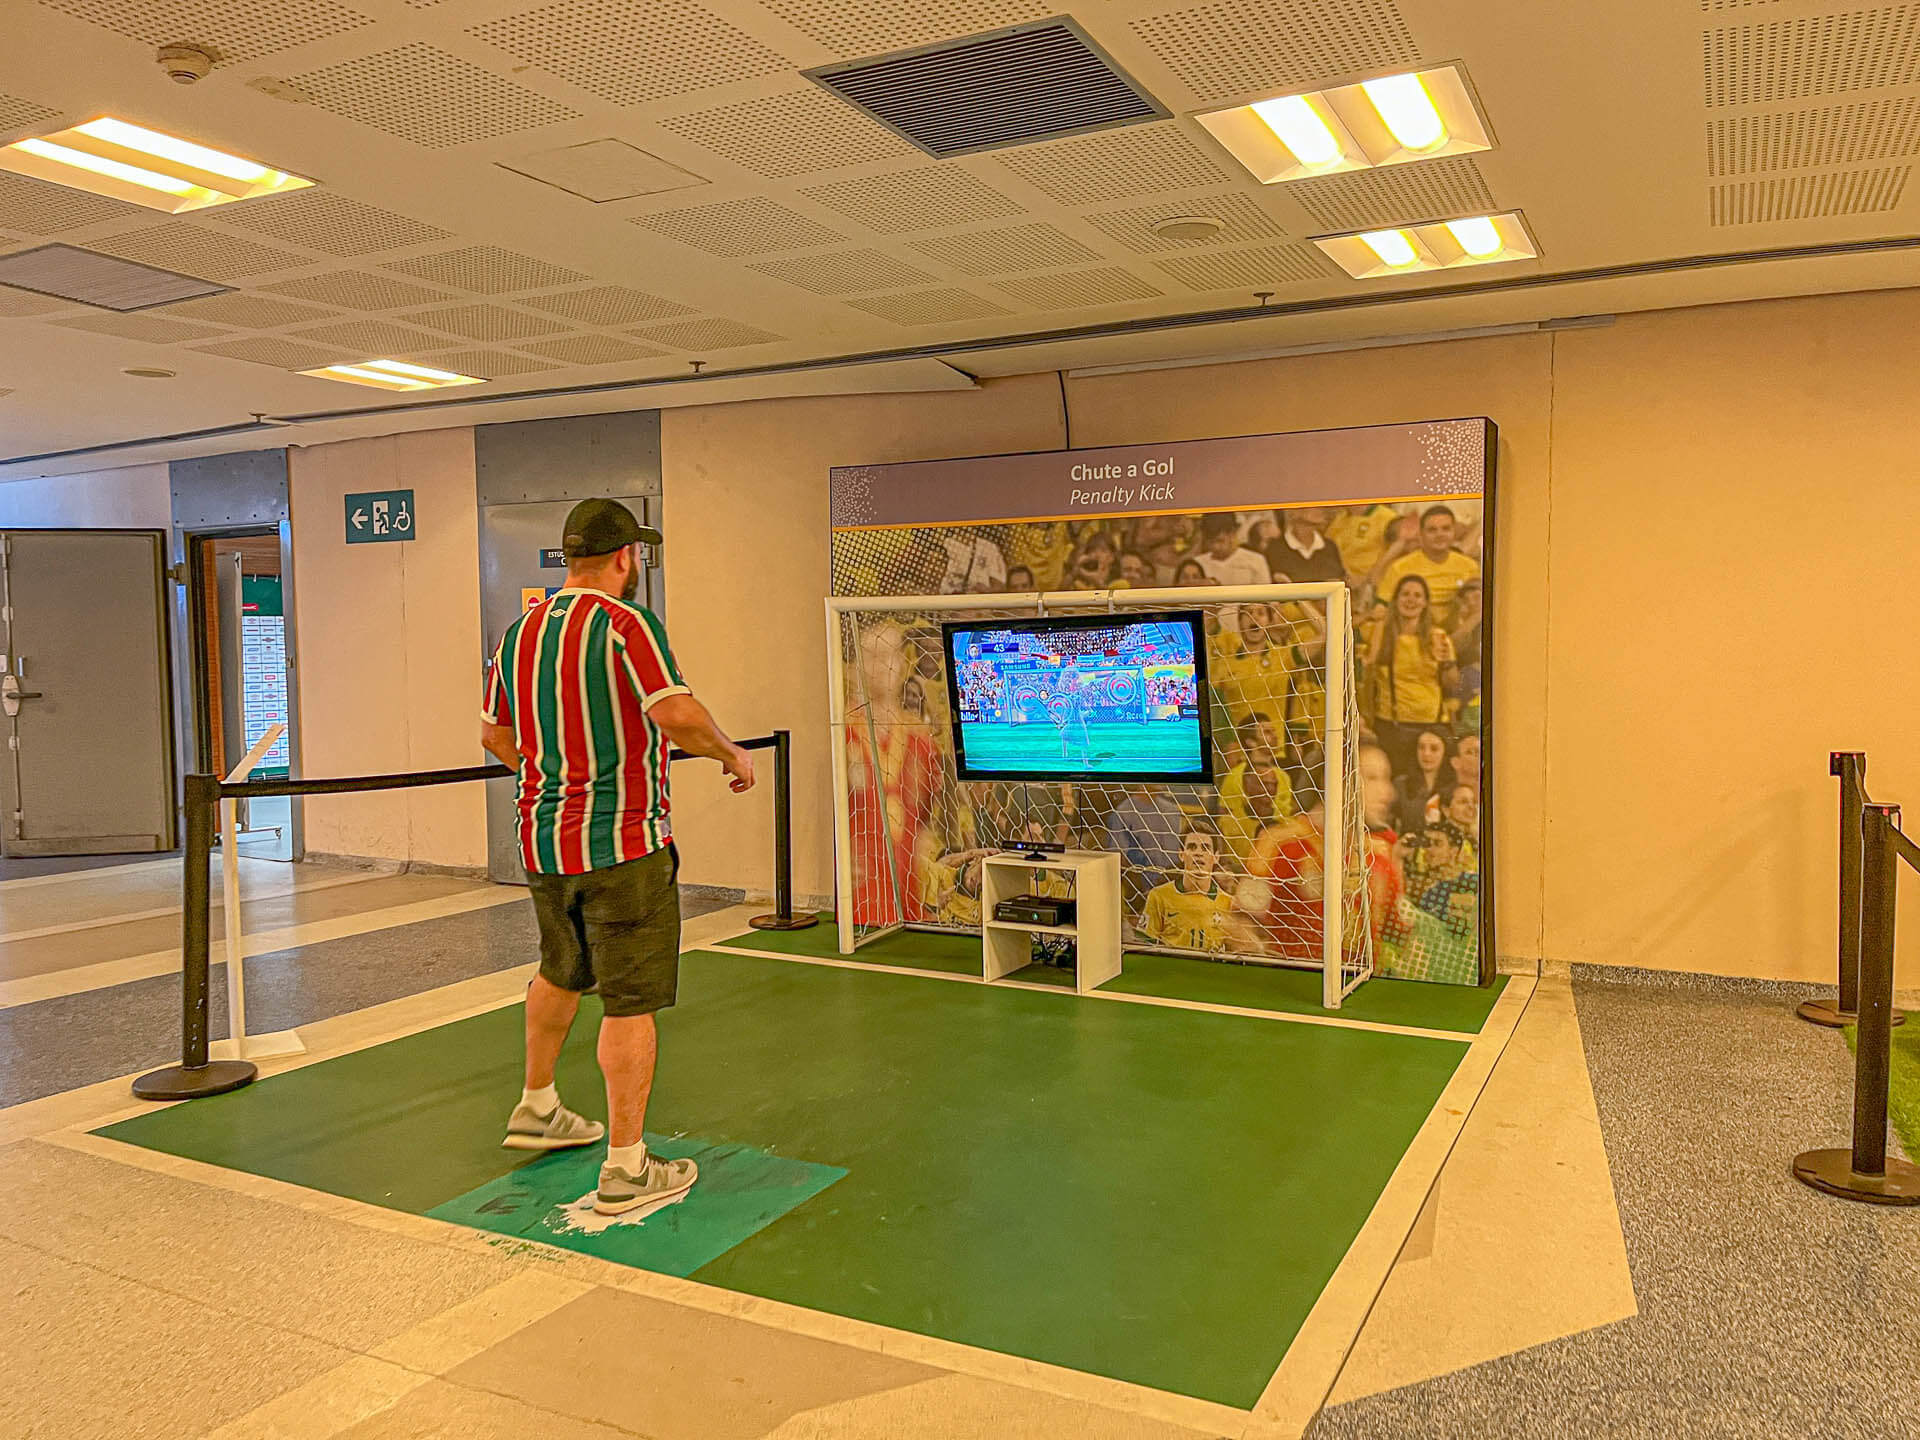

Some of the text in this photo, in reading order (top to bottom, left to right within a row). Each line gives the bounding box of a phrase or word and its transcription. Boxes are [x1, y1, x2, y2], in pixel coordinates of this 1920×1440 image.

[1070, 456, 1174, 481] Chute a Gol
[1070, 482, 1175, 506] Penalty Kick
[993, 643, 1005, 652] 43
[1190, 928, 1204, 948] 11
